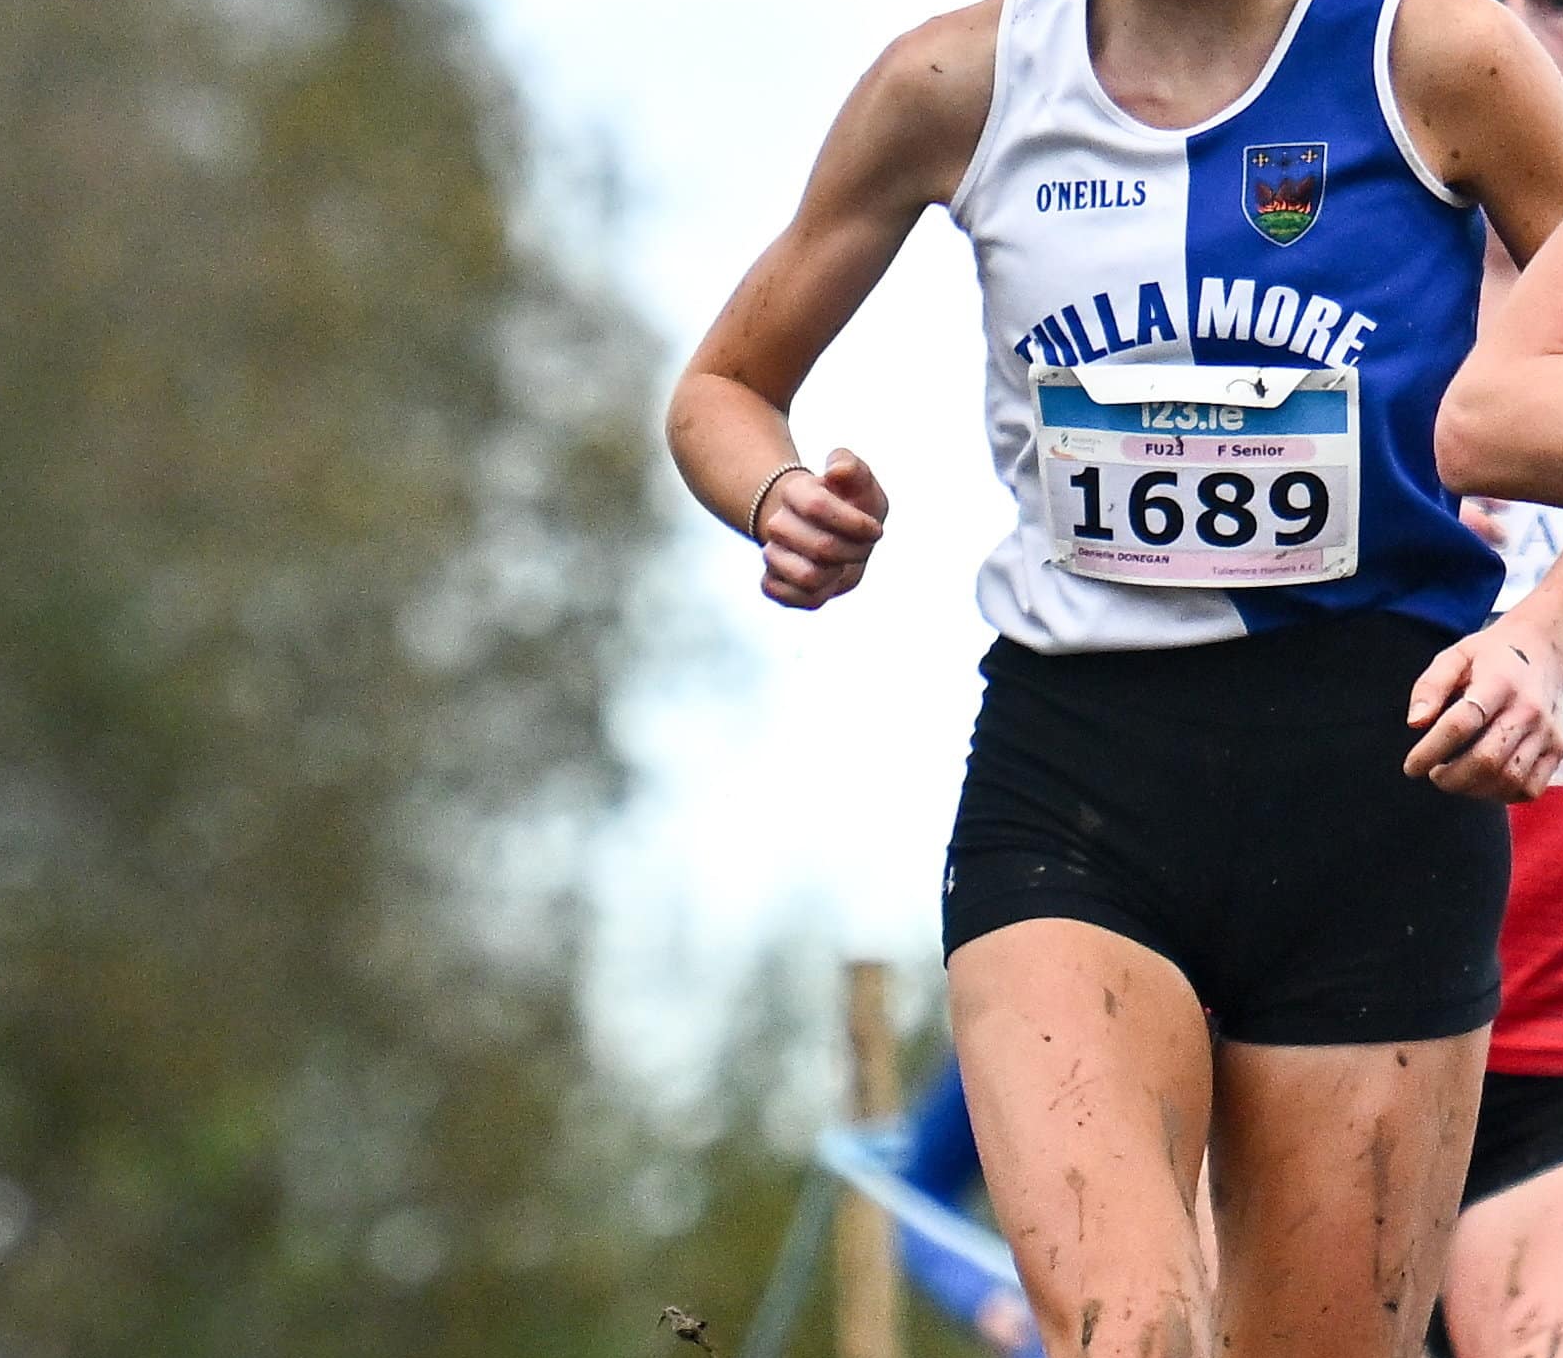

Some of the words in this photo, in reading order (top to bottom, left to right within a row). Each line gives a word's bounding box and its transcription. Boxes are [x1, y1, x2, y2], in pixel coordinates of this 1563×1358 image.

[1036, 180, 1146, 212] O'NEILLS
[1144, 443, 1185, 457] FU23
[1217, 444, 1227, 457] F
[1231, 443, 1285, 458] Senior
[1069, 466, 1330, 548] 1689
[1117, 552, 1170, 564] DONEGAN
